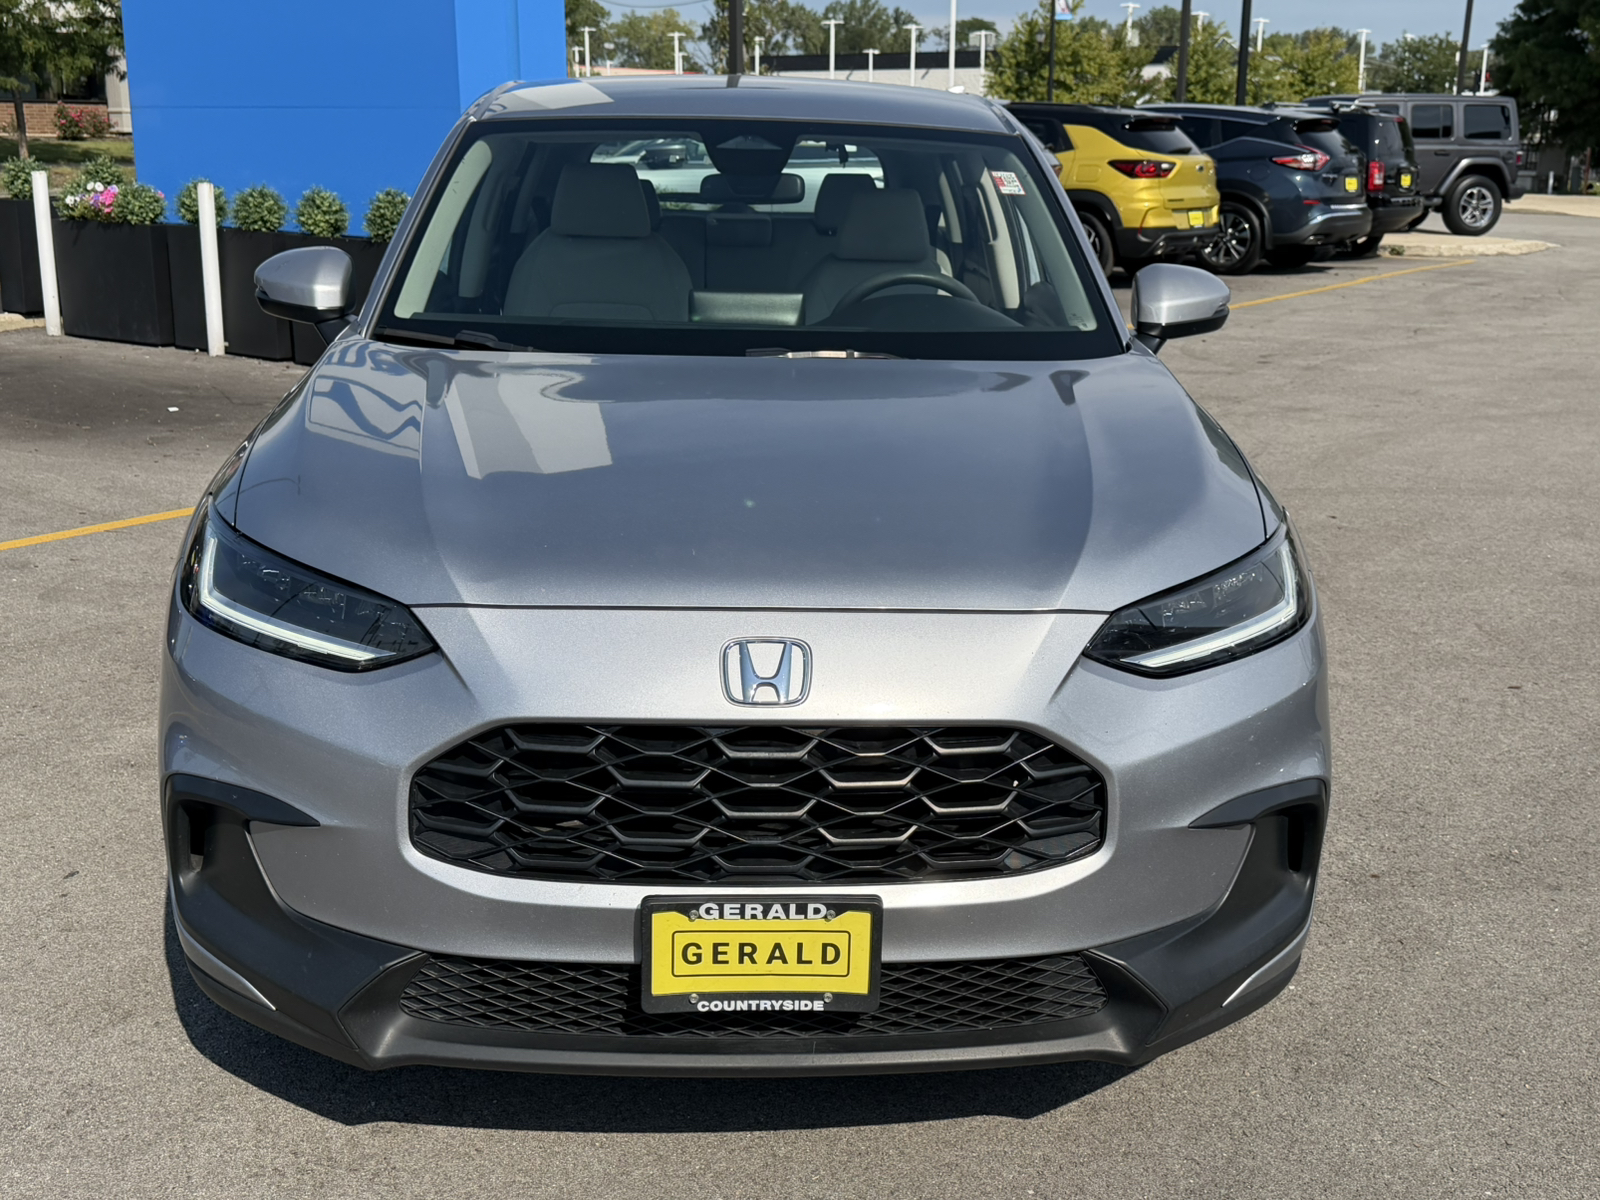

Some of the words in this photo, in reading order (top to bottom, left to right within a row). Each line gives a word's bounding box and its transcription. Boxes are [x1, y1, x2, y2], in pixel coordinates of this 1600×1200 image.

[698, 903, 827, 920] GERALD
[681, 942, 841, 965] GERALD
[696, 1000, 825, 1012] COUNTRYSIDE
